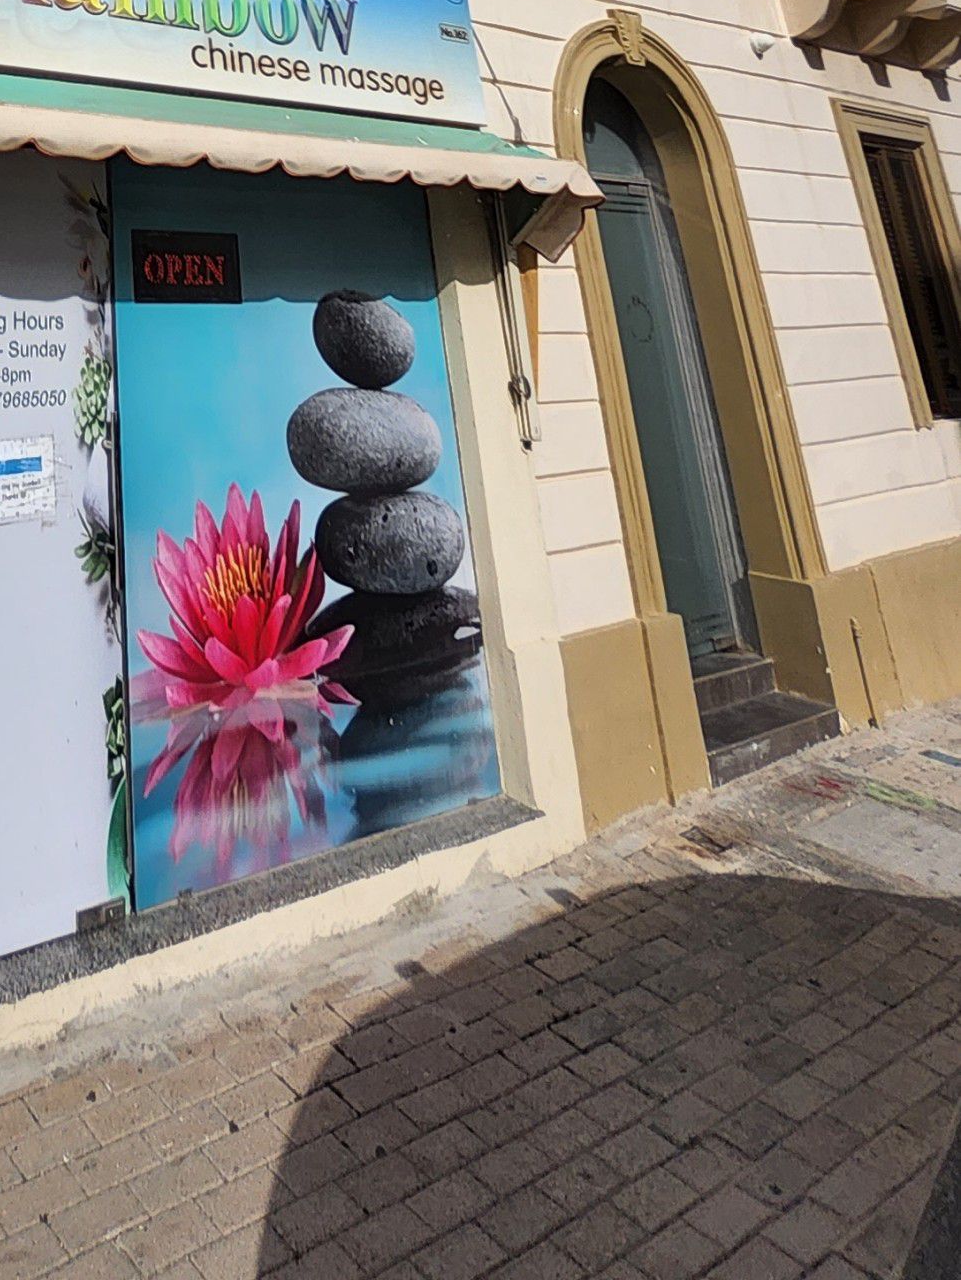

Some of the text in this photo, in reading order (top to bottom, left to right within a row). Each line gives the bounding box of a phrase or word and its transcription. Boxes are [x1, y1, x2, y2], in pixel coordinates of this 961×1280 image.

[191, 37, 444, 105] chinese massage
[143, 253, 225, 286] OPEN
[13, 310, 64, 330] Hours
[8, 339, 66, 361] Sunday
